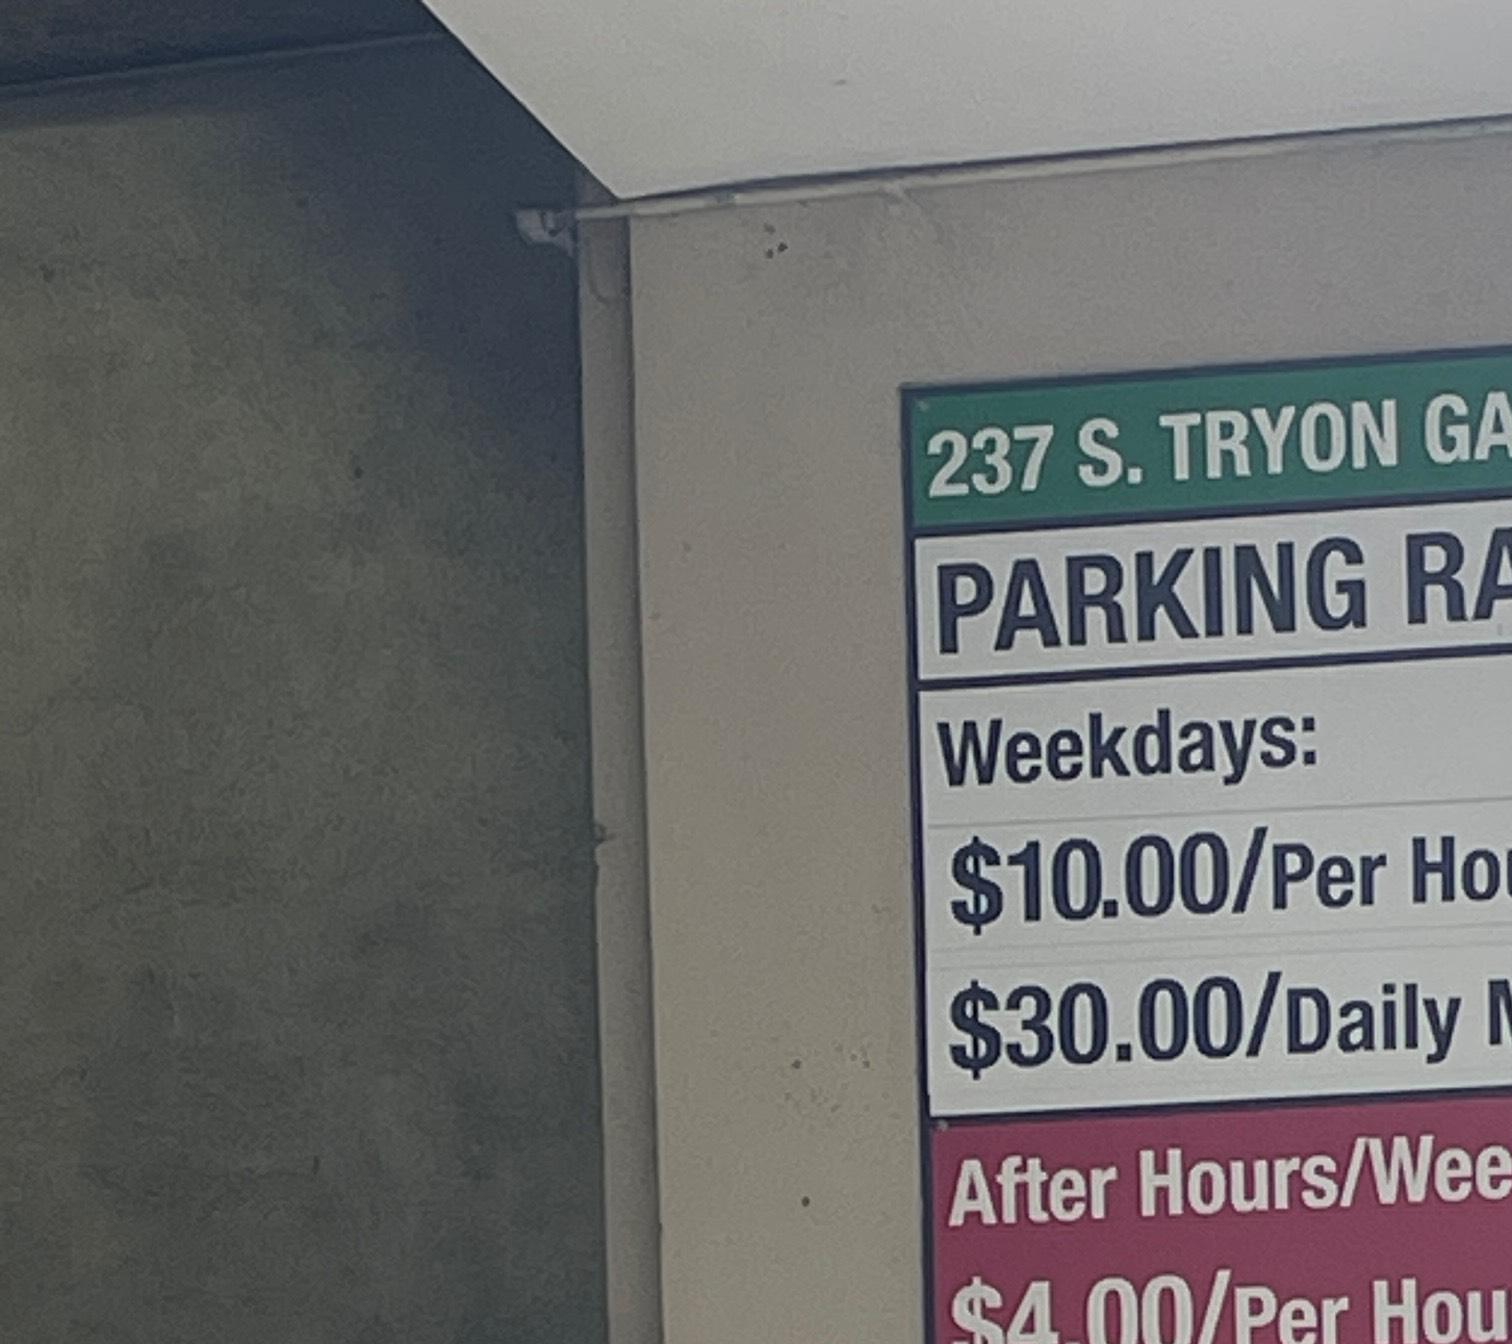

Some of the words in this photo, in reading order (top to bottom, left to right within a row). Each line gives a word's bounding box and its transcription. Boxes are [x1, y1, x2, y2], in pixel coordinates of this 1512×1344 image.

[926, 423, 1053, 497] 237
[1078, 419, 1142, 488] S.
[1161, 398, 1398, 481] TRYON
[936, 537, 1368, 656] PARKING
[936, 708, 1317, 788] Weekdays:
[950, 826, 1387, 935] $10.00/Per
[949, 972, 1461, 1080] $30.00/Daily
[948, 1157, 1117, 1228] After
